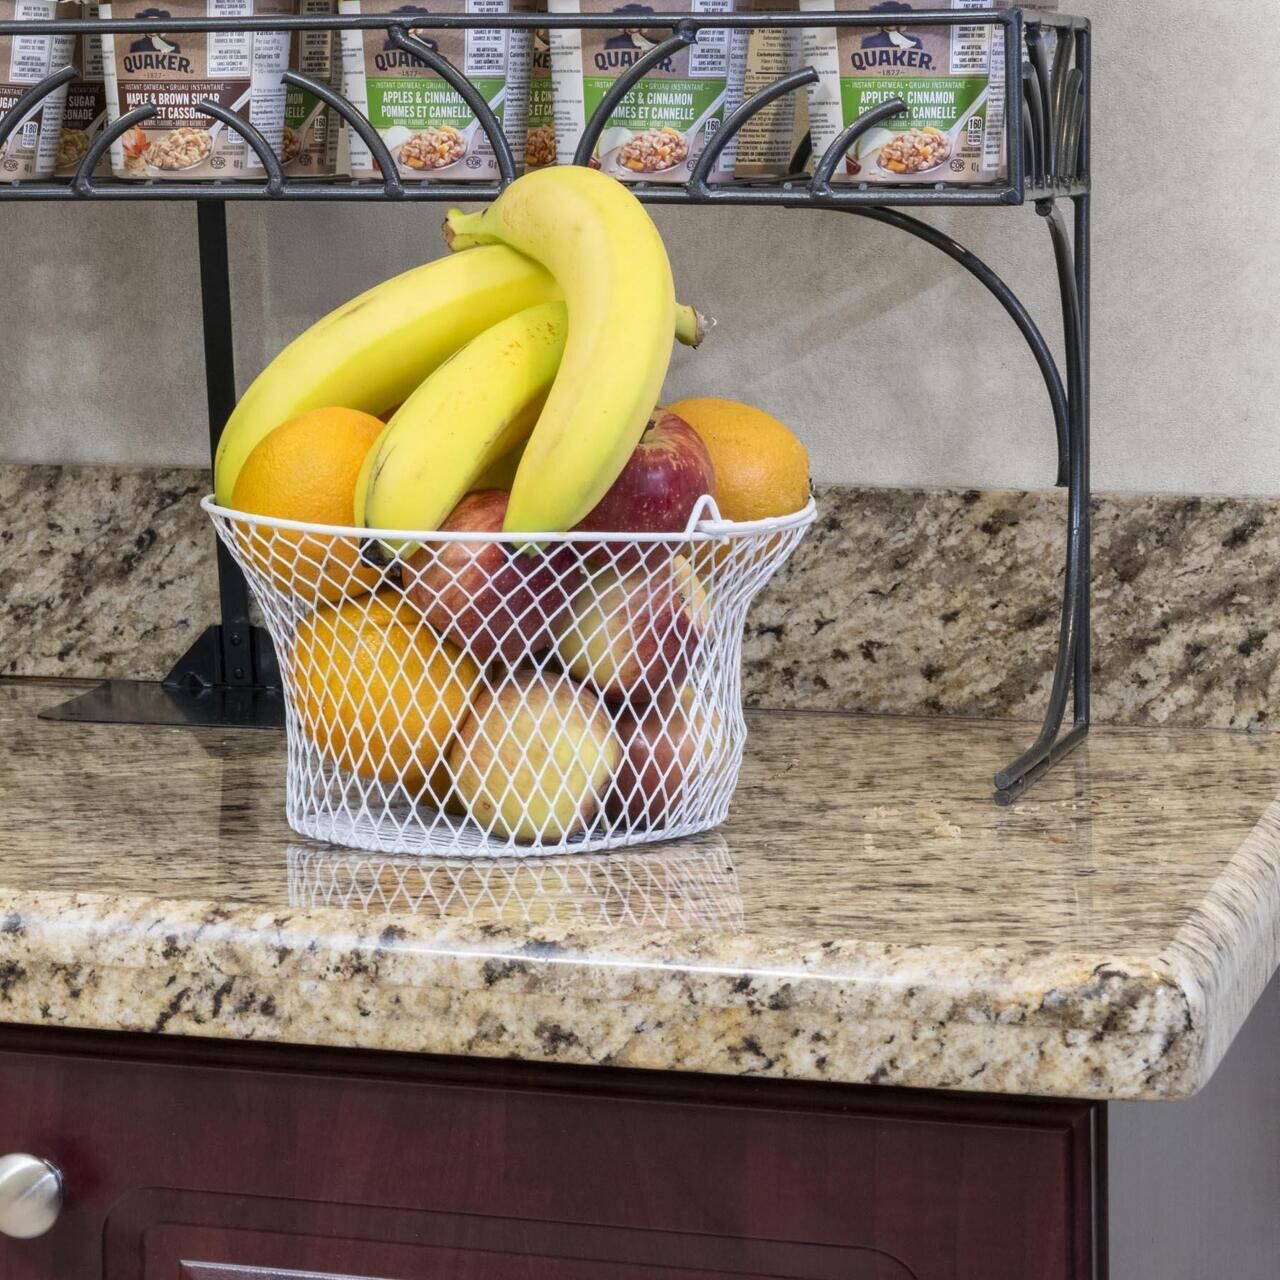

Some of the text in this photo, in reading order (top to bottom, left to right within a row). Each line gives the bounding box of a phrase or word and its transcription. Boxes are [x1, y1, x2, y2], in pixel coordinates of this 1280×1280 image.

[124, 54, 190, 74] QUAKER
[851, 50, 932, 70] QUAKER
[127, 93, 189, 104] MAPLE & BROWN
[383, 91, 422, 104] APPLES &
[638, 93, 693, 105] & CINNAMON
[907, 91, 954, 103] CINNAMON
[381, 105, 472, 118] POMMES ET CANNELLE
[639, 107, 694, 120] ET CANNELLE
[913, 107, 956, 119] CANNELLE
[25, 123, 36, 133] 180
[970, 119, 981, 129] 160
